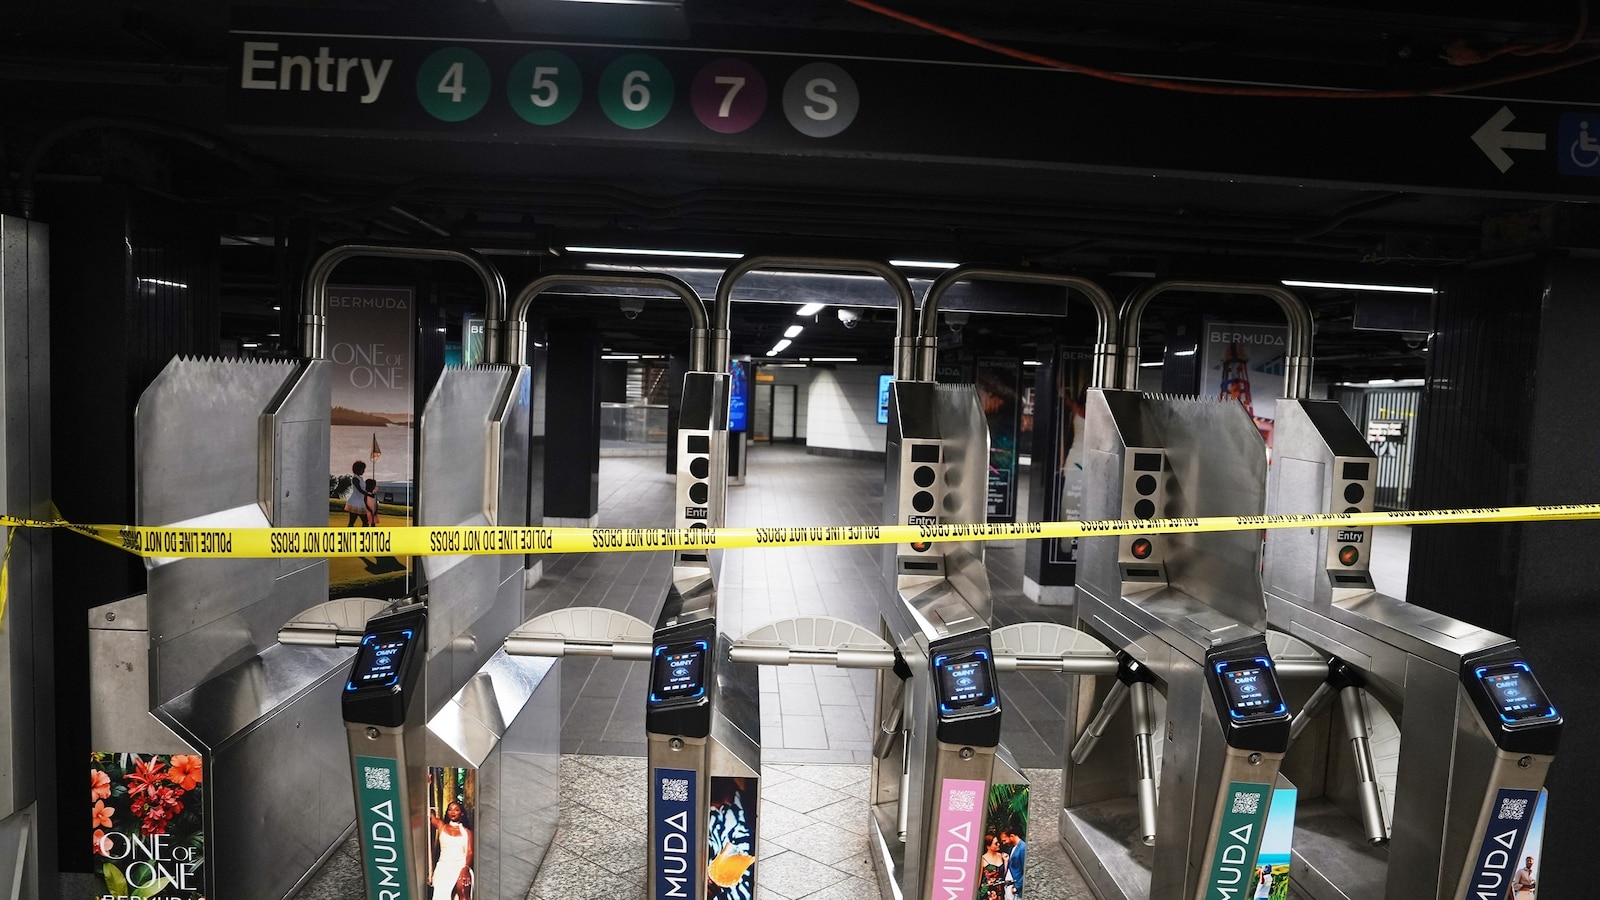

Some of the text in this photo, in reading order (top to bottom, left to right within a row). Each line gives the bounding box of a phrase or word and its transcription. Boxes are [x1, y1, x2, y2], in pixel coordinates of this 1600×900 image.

[241, 41, 838, 121] Entry 4 5 6 7 S
[329, 296, 407, 309] BERMUDA
[1210, 331, 1284, 346] BERMUDA
[331, 342, 404, 366] ONE OF
[350, 366, 404, 389] ONE
[909, 516, 936, 525] Entry
[144, 531, 162, 553] NOT
[164, 531, 177, 553] DO
[179, 532, 199, 553] LINE
[201, 532, 232, 553] POLICE
[270, 531, 391, 553] POLICE LINE DO NOT CROSS
[430, 529, 552, 552] POLICE LINE DO NOT CROSS
[592, 528, 716, 548] POLICE LINE DO NOT CROSS
[1337, 531, 1363, 543] Entry
[670, 659, 693, 667] OMNY
[952, 669, 975, 677] OMNY
[1234, 676, 1257, 684] OMNY
[1495, 680, 1518, 688] OMNY
[100, 832, 196, 861] ONE OF
[664, 810, 688, 897] MUDA
[125, 861, 197, 890] ONE
